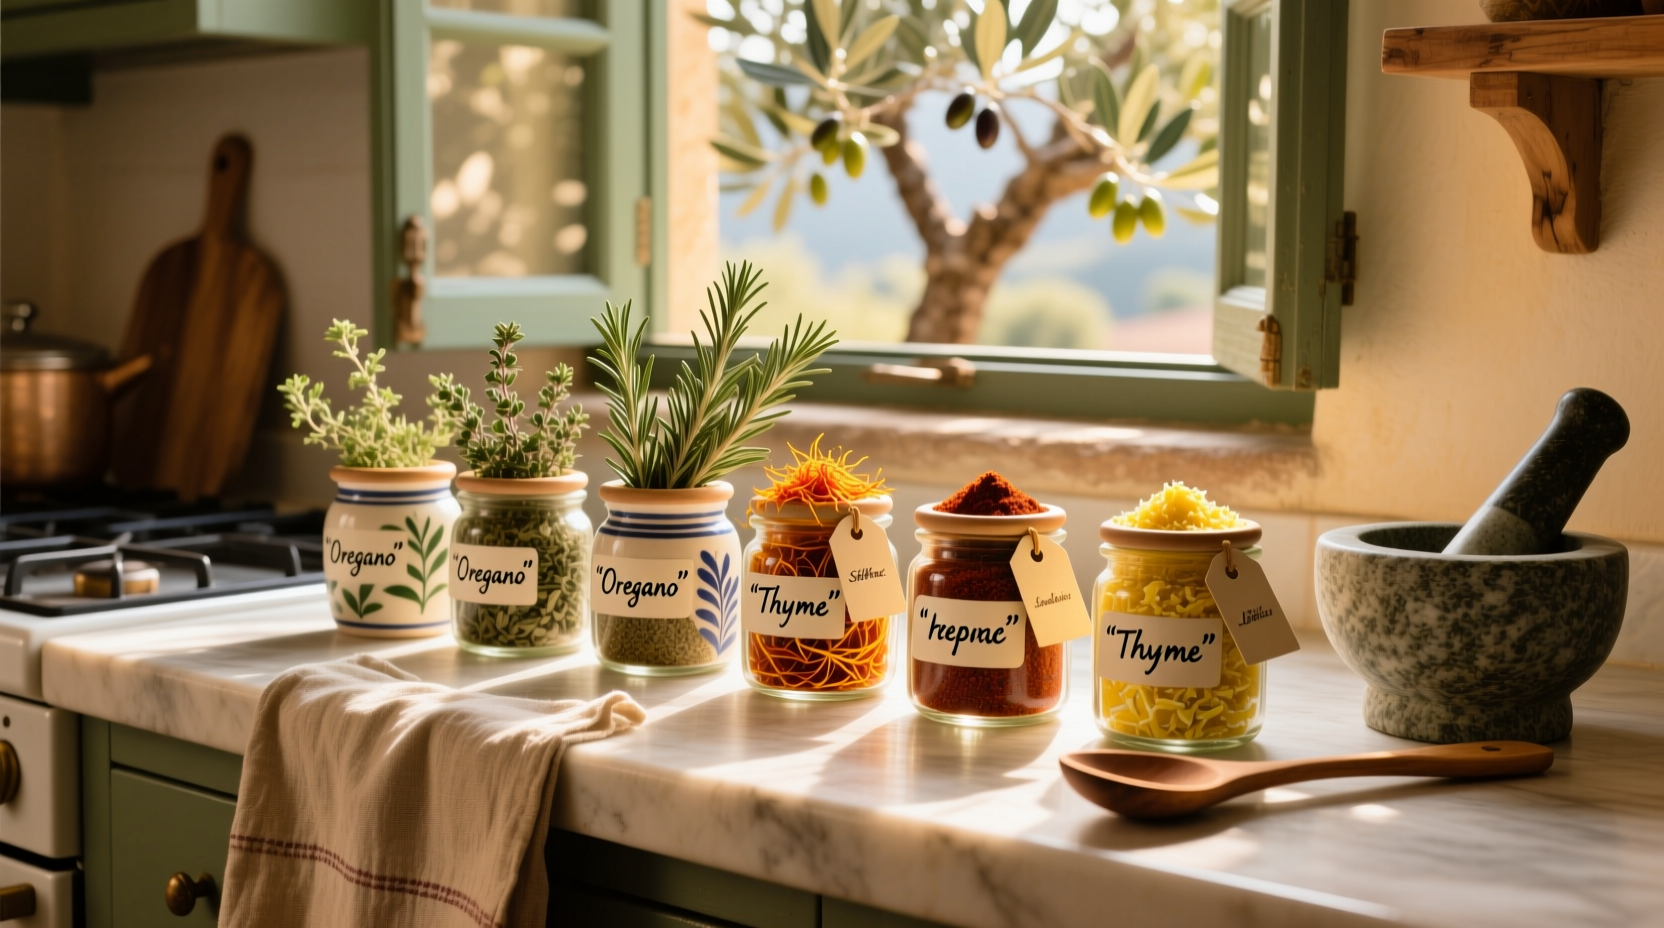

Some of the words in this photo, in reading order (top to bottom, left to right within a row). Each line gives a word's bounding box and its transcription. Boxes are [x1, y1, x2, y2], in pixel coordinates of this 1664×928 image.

[452, 552, 533, 595] “Oregano”
[595, 566, 689, 608] “Oregano”
[750, 583, 842, 628] “Thyme”
[1106, 625, 1218, 675] “Thyme”
